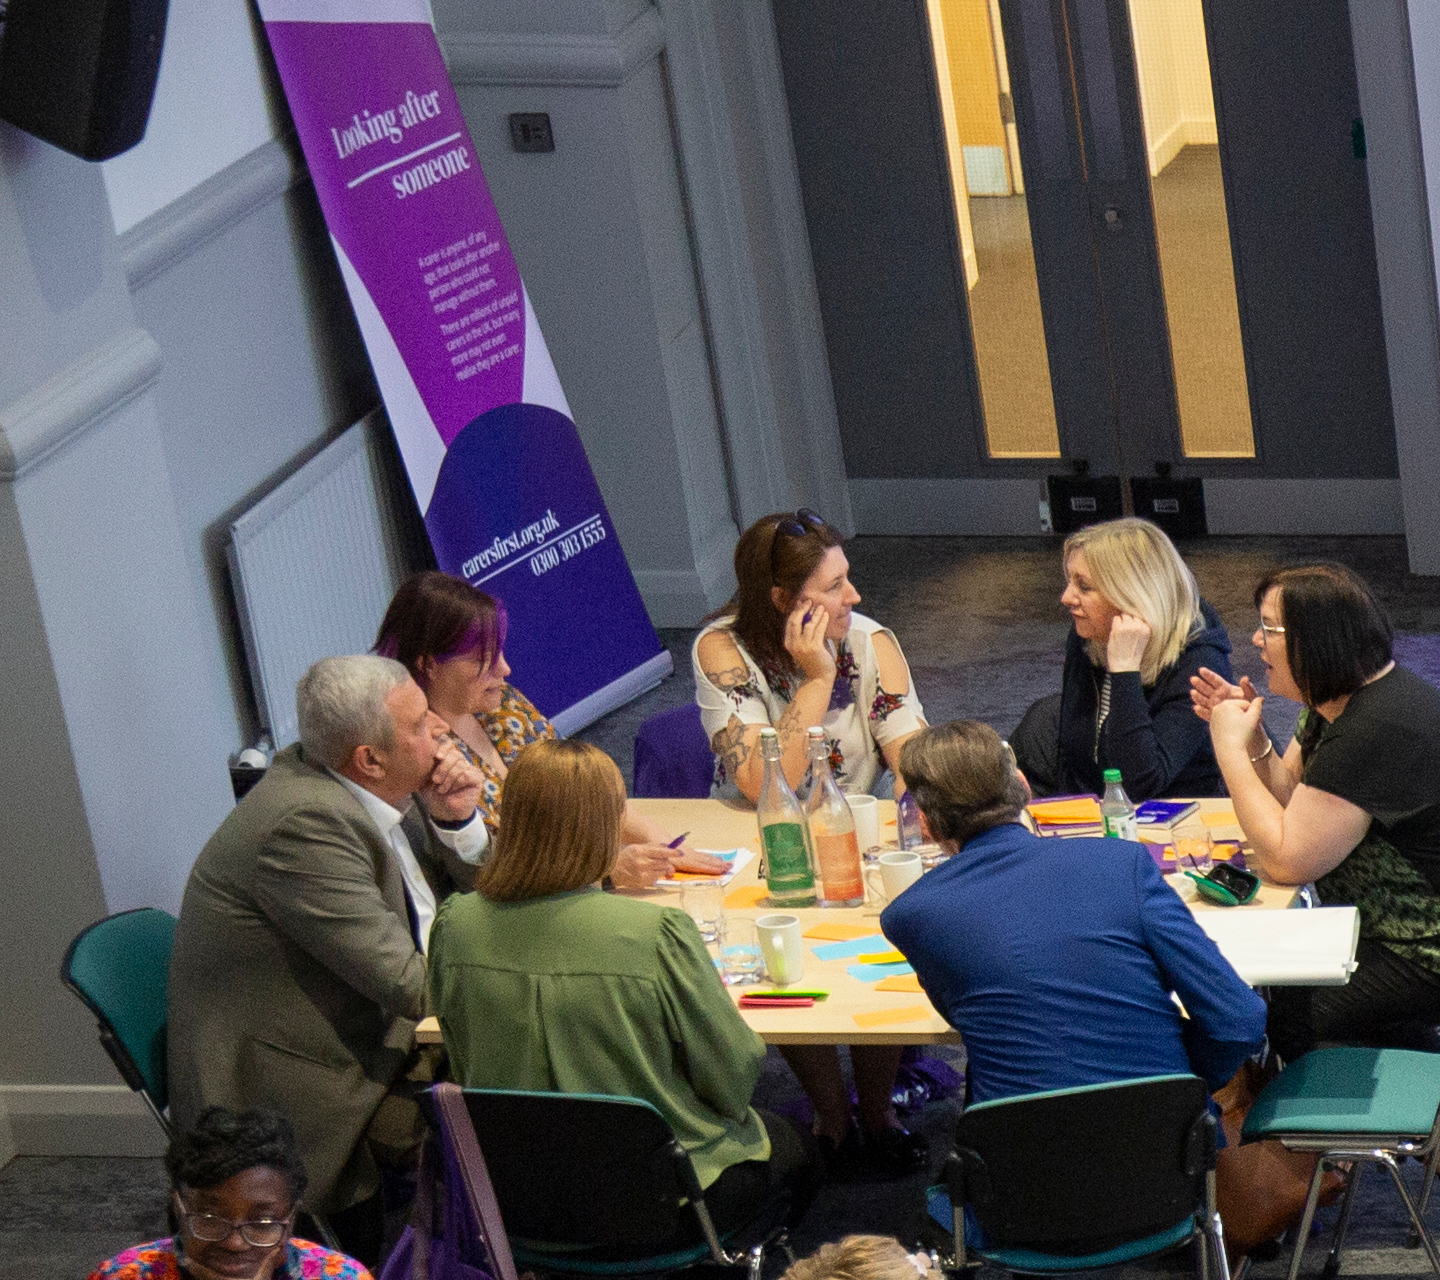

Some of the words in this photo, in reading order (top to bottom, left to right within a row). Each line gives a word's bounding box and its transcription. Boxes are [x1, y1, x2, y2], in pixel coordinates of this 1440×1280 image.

[331, 109, 403, 159] Looking
[399, 90, 441, 129] after
[392, 146, 471, 200] someone
[462, 509, 560, 579] carersfirst.org.uk
[530, 546, 560, 577] 0300
[558, 534, 581, 561] 303
[580, 520, 606, 550] 1555
